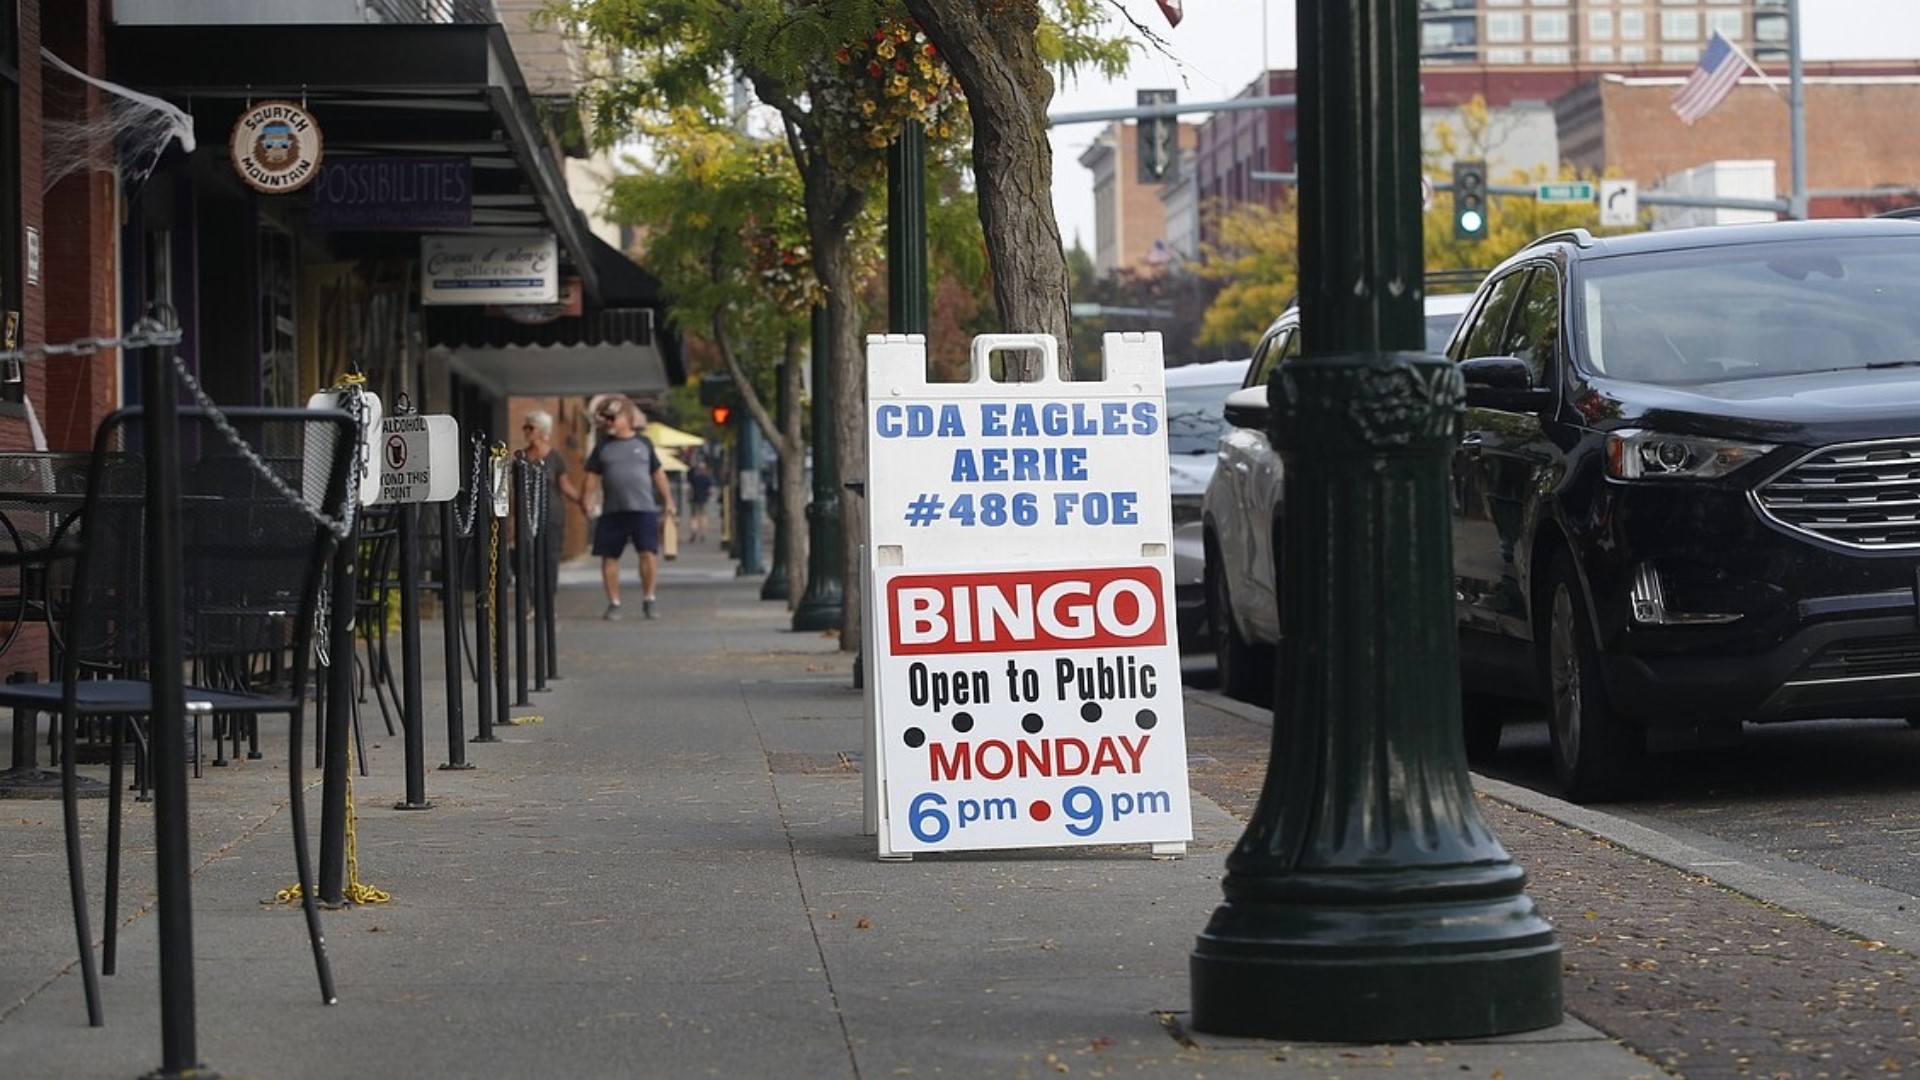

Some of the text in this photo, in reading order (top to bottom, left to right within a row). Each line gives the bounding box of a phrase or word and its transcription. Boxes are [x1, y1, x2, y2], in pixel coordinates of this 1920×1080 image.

[245, 107, 309, 132] SQUATCH
[242, 157, 311, 186] MOUNTAIN
[314, 163, 465, 204] POSSIBILITIES
[382, 418, 426, 433] ALCOHOL
[876, 402, 1159, 438] CDA EAGLES
[407, 471, 428, 484] THIS
[951, 448, 1088, 482] AERIE
[384, 486, 412, 500] POINT
[904, 492, 1139, 527] #486 FOE
[897, 578, 1157, 645] BINGO
[909, 655, 1157, 712] Open to Public
[929, 735, 1151, 782] MONDAY
